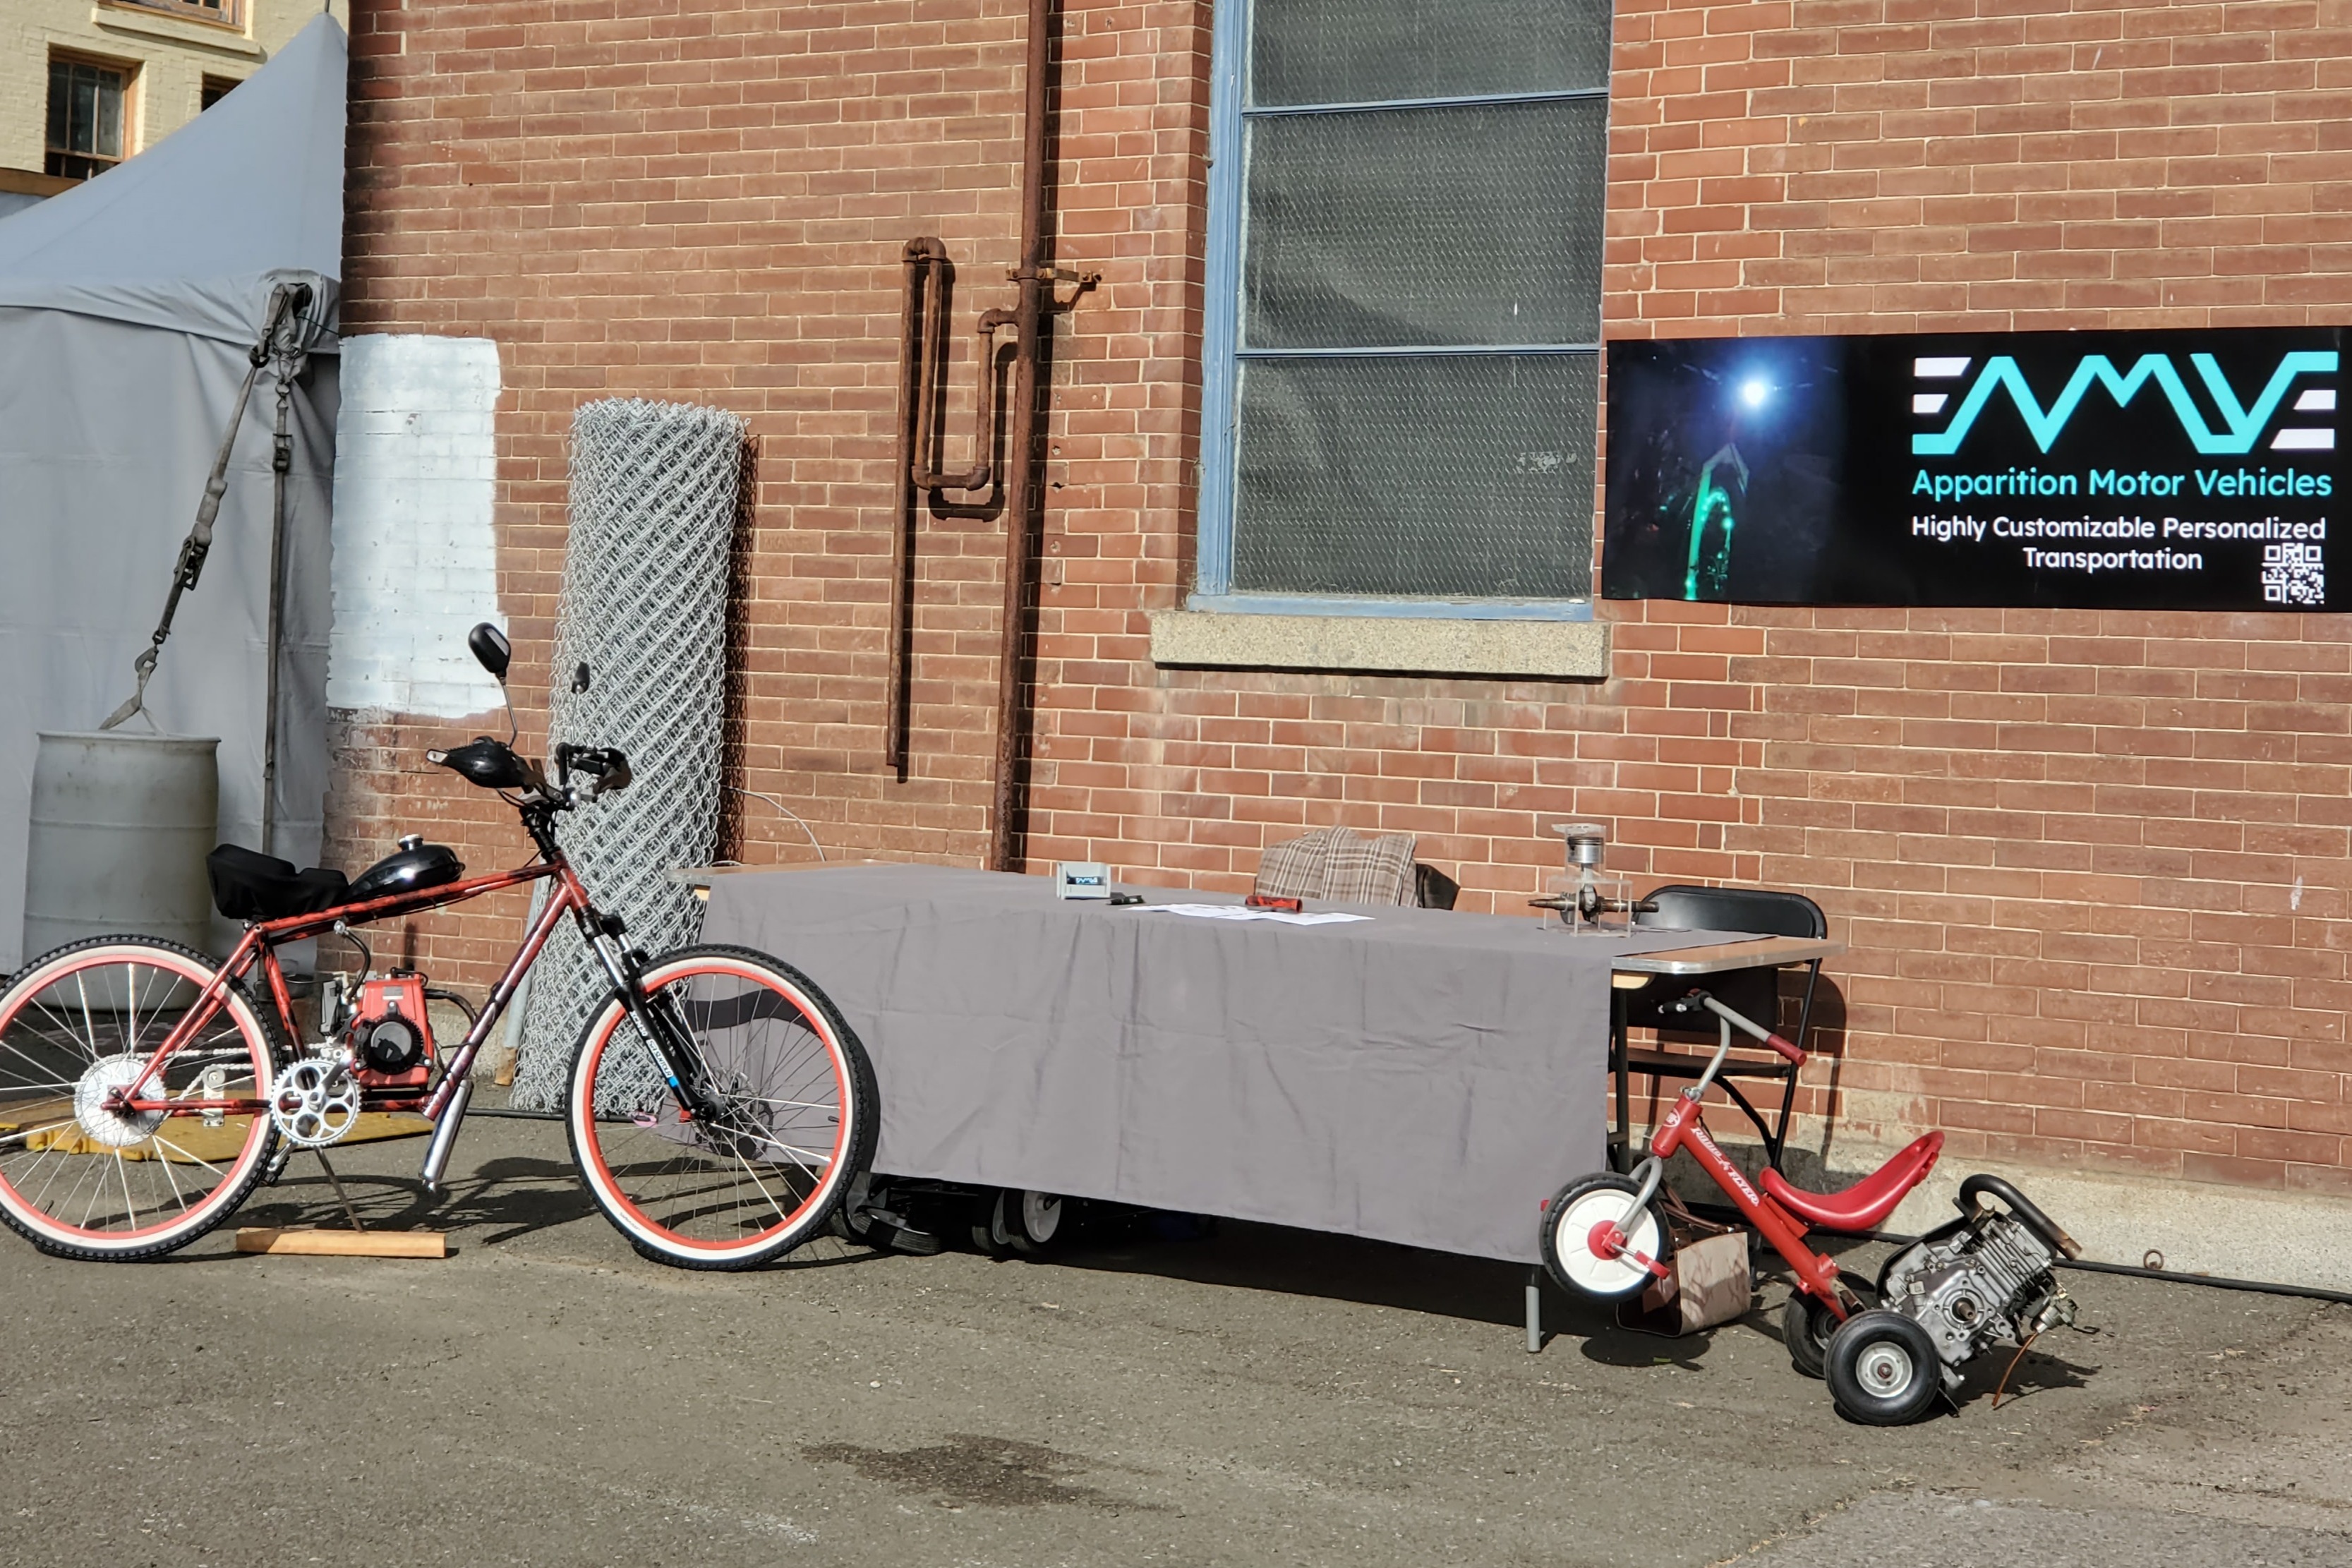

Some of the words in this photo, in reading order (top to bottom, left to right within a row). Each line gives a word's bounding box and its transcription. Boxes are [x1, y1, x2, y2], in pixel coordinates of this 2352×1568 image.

[1912, 466, 2077, 502] Apparition
[2089, 469, 2185, 496] Motor
[2194, 467, 2332, 497] Vehicles
[1912, 514, 1986, 542] Highly
[1992, 516, 2156, 538] Customizable
[2163, 517, 2325, 540] Personalized
[2023, 546, 2202, 573] Transportation
[655, 1050, 673, 1076] SUNTOUR
[1728, 1169, 1760, 1207] FLYER
